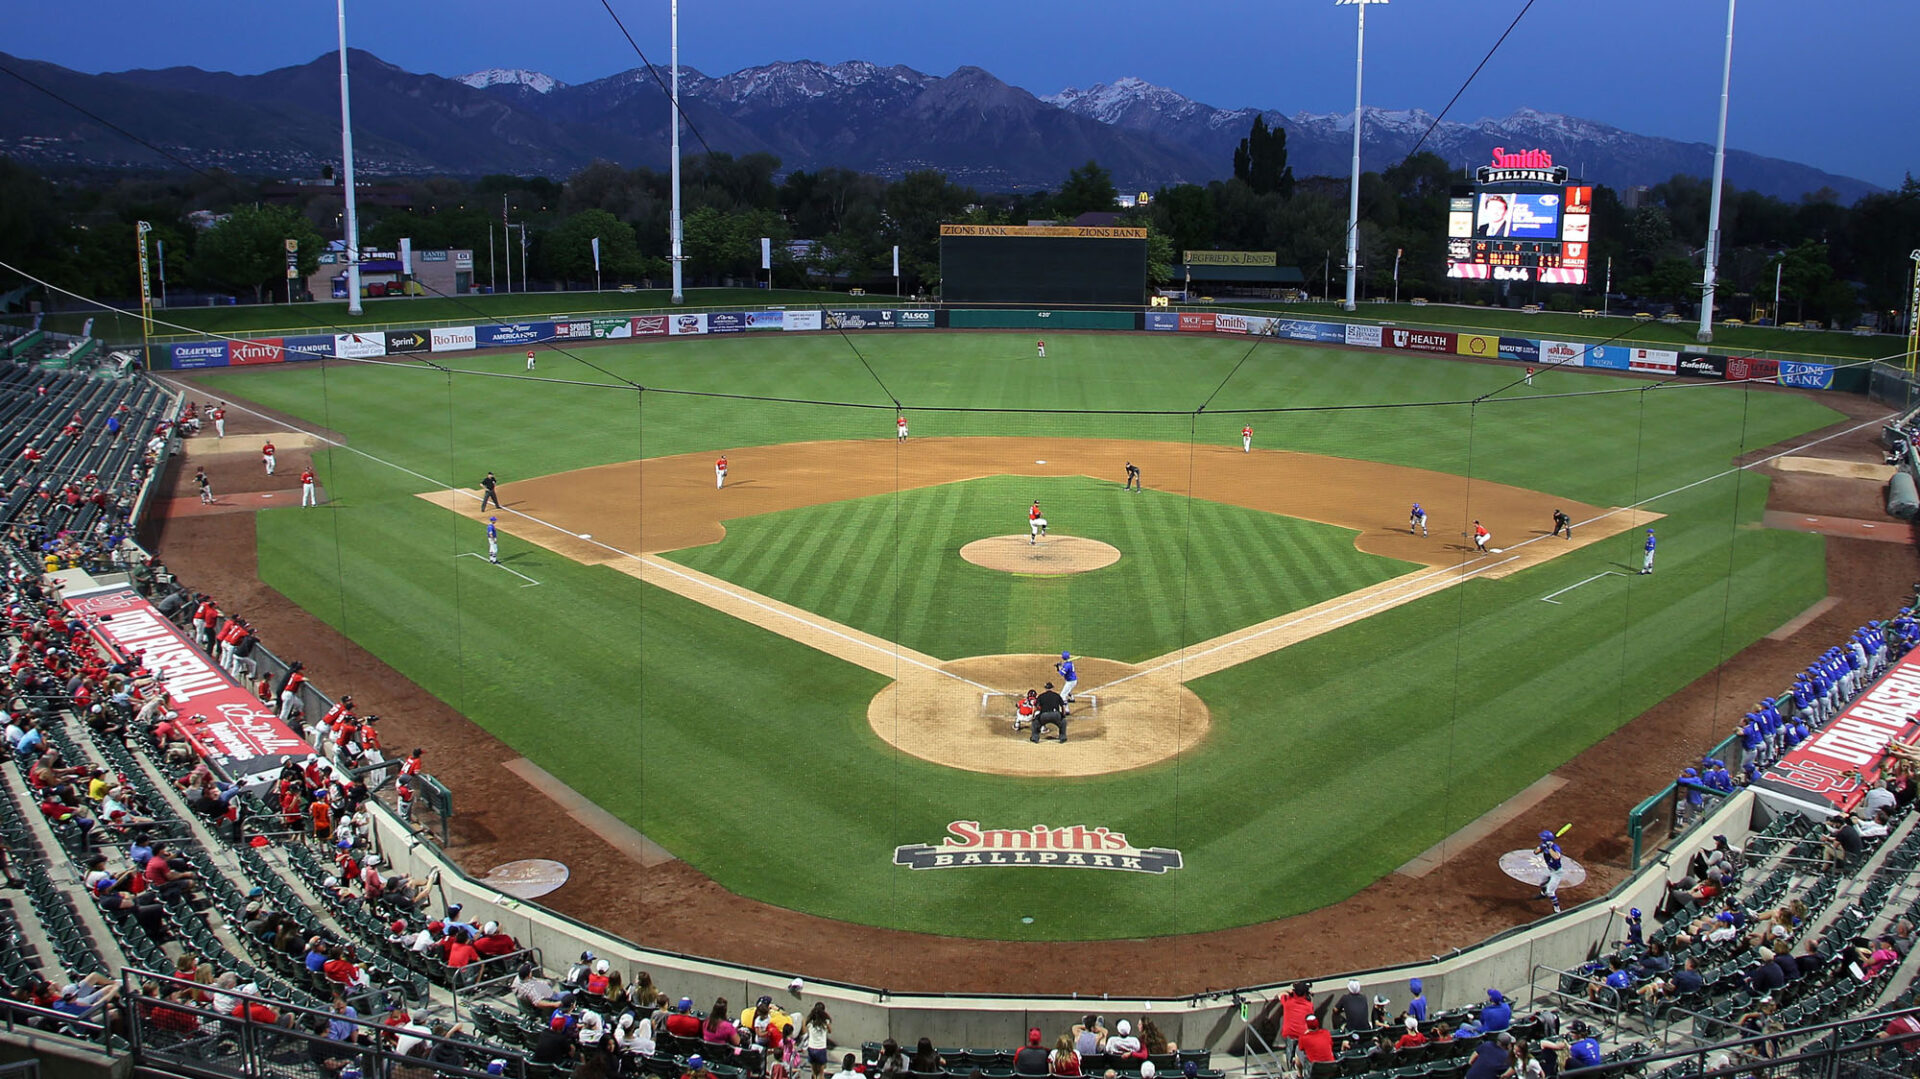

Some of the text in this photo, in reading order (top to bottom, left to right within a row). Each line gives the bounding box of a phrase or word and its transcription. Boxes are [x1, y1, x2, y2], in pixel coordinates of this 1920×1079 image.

[1491, 147, 1552, 168] Smith's
[1488, 171, 1554, 182] BALLPARK
[944, 227, 975, 235] ZIONS
[979, 227, 1007, 236] BANK
[1079, 228, 1110, 237] ZIONS
[1113, 229, 1142, 238] BANK
[1242, 253, 1275, 264] JENSEN
[569, 322, 591, 332] SPORTS
[1217, 315, 1246, 329] Smith's
[391, 338, 414, 347] Sprint
[1411, 335, 1446, 346] HEALTH
[232, 344, 282, 361] xfinity
[297, 344, 332, 353] FANDUEL
[1681, 361, 1714, 370] Safelite
[1787, 364, 1824, 375] ZIONS
[1787, 375, 1824, 386] BANK
[100, 608, 169, 642] UTAH
[228, 625, 241, 639] 11
[124, 634, 230, 703] BASEBALL
[1808, 718, 1898, 765] UTAH
[945, 821, 1127, 850] Smith's
[934, 852, 1142, 870] BALLPARK
